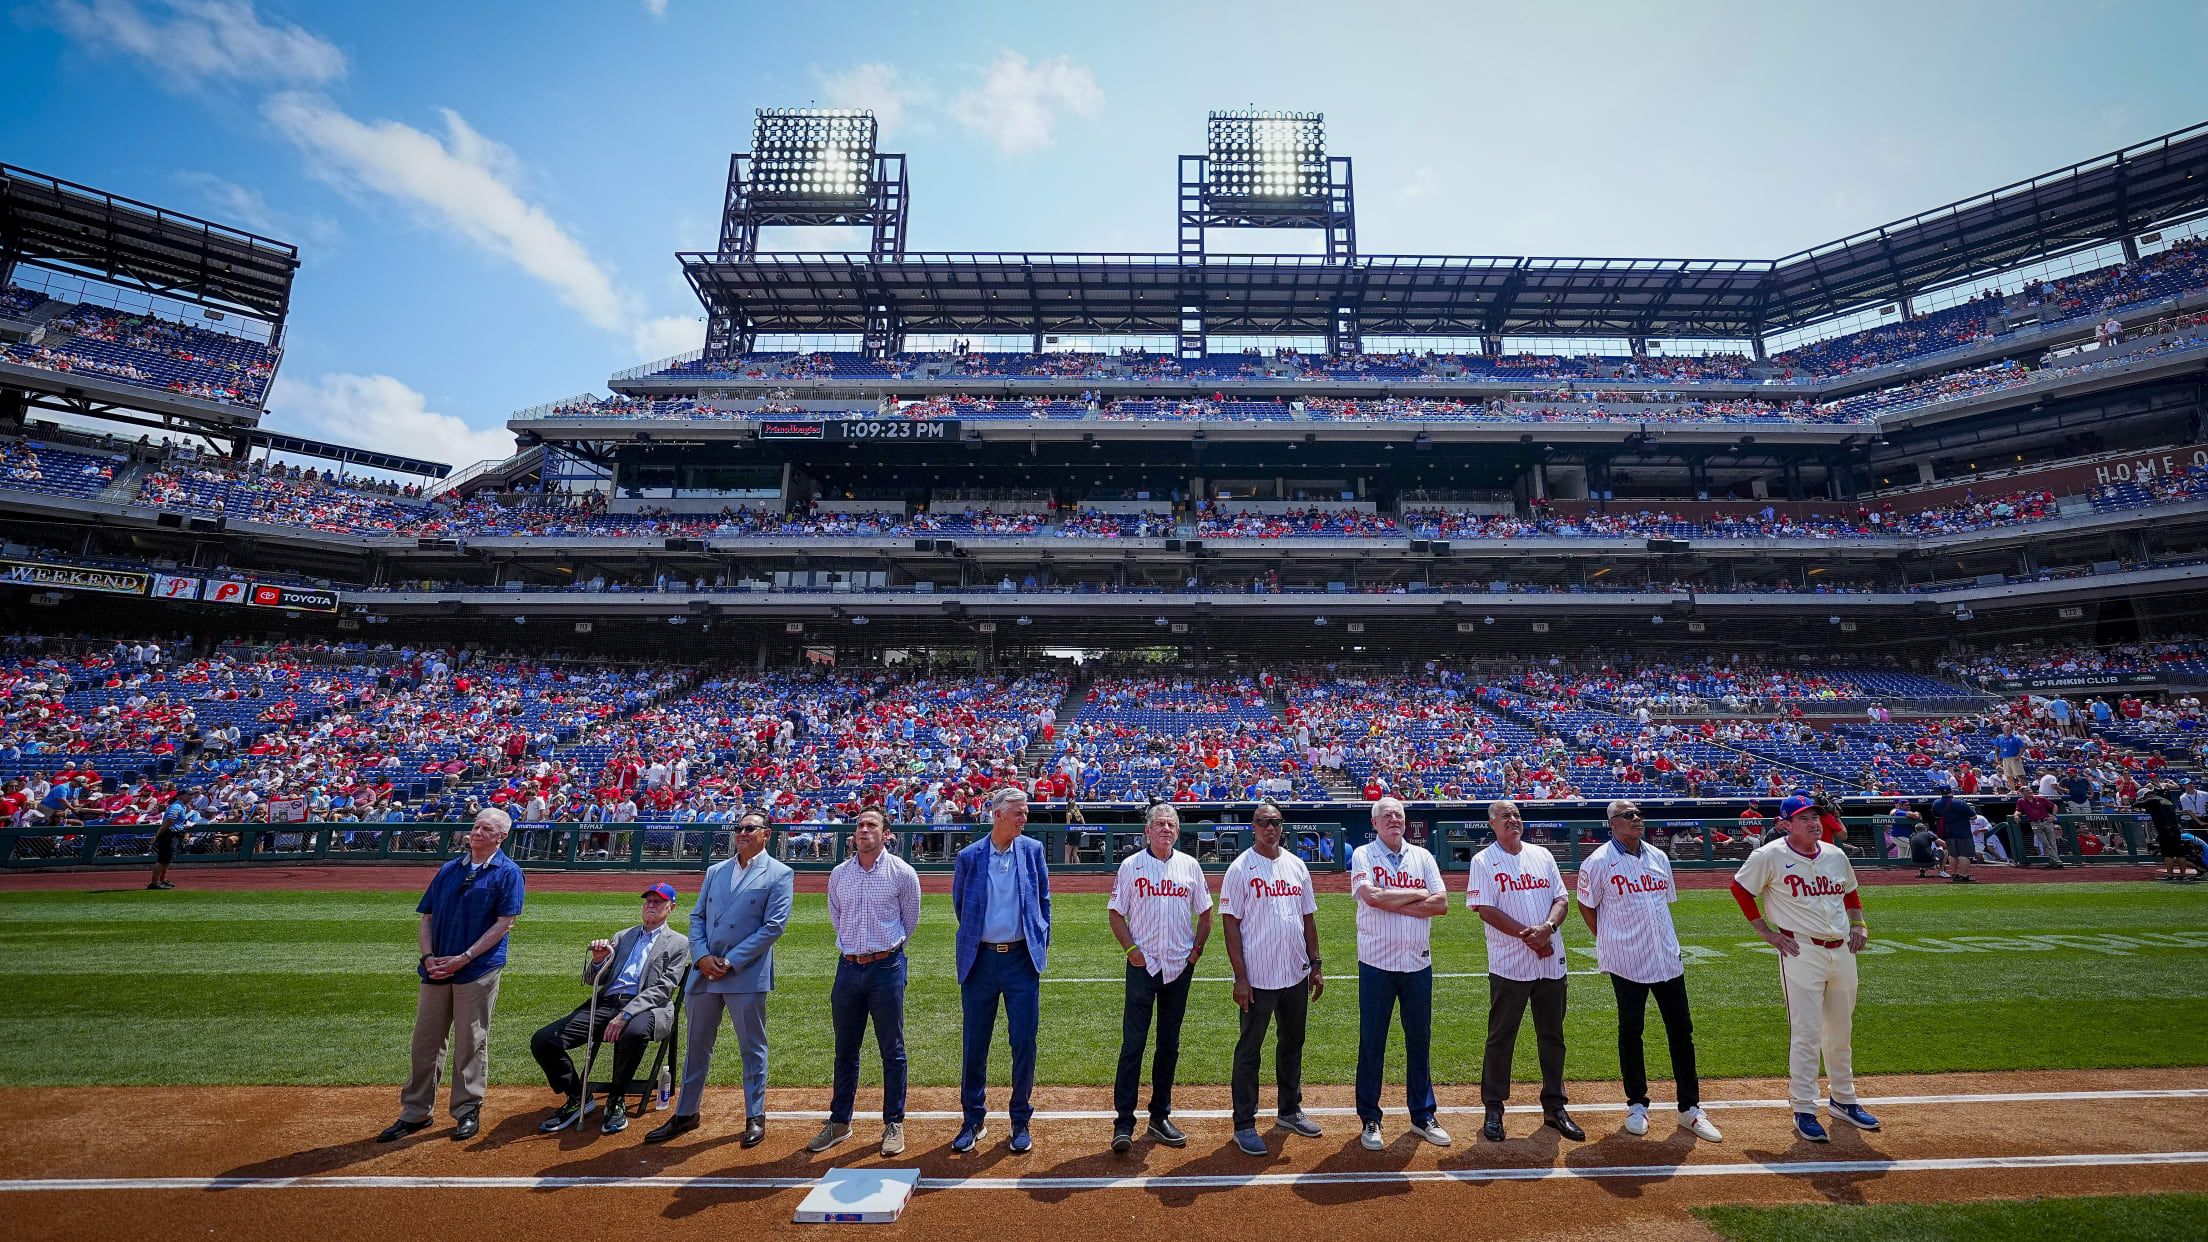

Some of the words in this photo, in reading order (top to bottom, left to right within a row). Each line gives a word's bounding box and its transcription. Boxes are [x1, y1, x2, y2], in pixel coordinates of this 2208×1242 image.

[841, 422, 911, 438] 1:09:23
[916, 422, 944, 438] PM
[8, 566, 139, 590] WEEKEND
[283, 593, 331, 606] TOYOTA
[2064, 608, 2077, 617] 122
[2032, 680, 2046, 688] CP
[2047, 678, 2086, 687] RANKIN
[2086, 676, 2119, 685] CLUB
[1135, 877, 1188, 898] Phillies
[1250, 877, 1302, 899] Phillies
[1373, 866, 1427, 889] Phillies
[1494, 872, 1550, 892] Phillies
[1611, 874, 1669, 895] Phillies
[1784, 874, 1846, 897] Phillies
